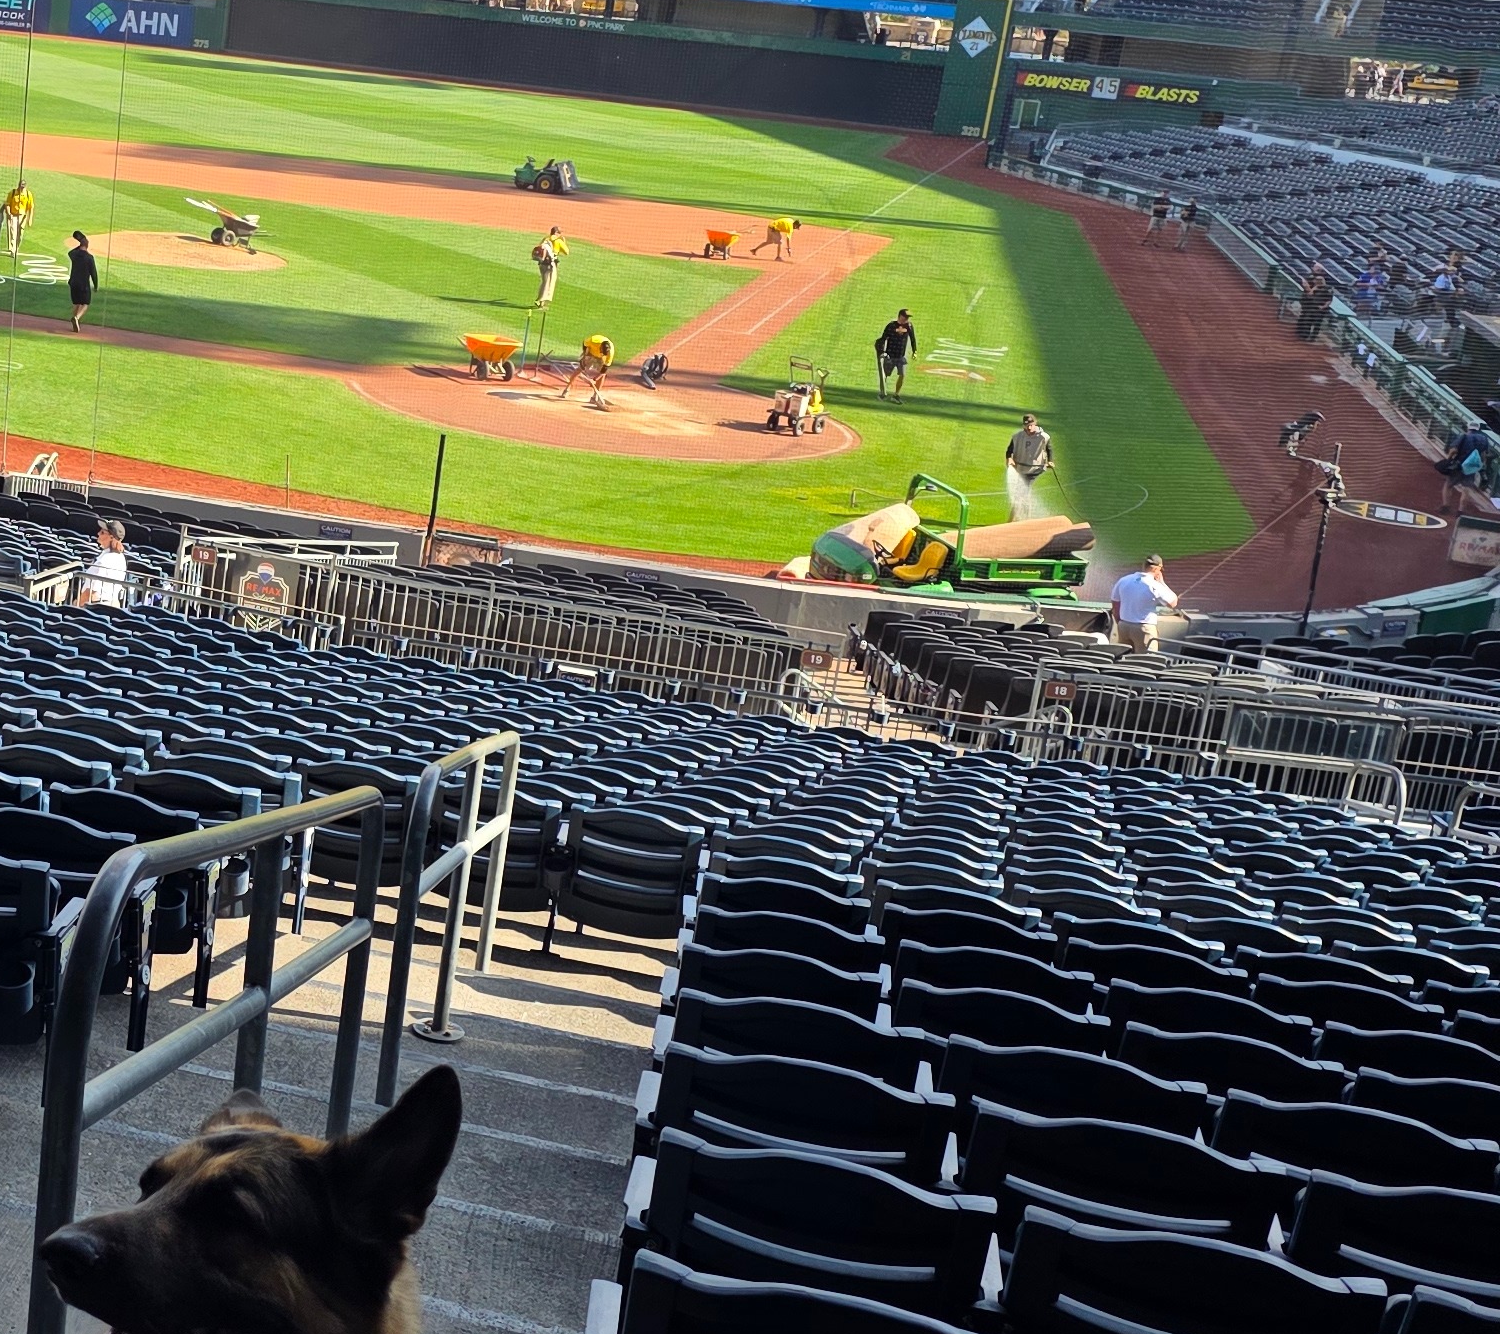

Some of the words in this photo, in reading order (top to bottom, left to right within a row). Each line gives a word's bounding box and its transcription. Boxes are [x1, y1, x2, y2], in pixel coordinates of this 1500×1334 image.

[119, 9, 179, 37] AHN
[521, 13, 564, 27] WELCOME
[565, 18, 577, 27] TO
[587, 20, 604, 30] PNC
[604, 22, 626, 32] PARK
[193, 38, 210, 49] 375
[969, 41, 979, 51] 21
[1024, 73, 1091, 93] BOWSER
[1134, 85, 1200, 104] BLASTS
[320, 525, 351, 534] CAUTION
[199, 550, 210, 560] 19
[625, 570, 659, 581] CAUTION
[246, 582, 282, 597] RE/MAX
[925, 609, 959, 619] CAUTION
[811, 654, 823, 665] 19
[1054, 686, 1068, 696] 18
